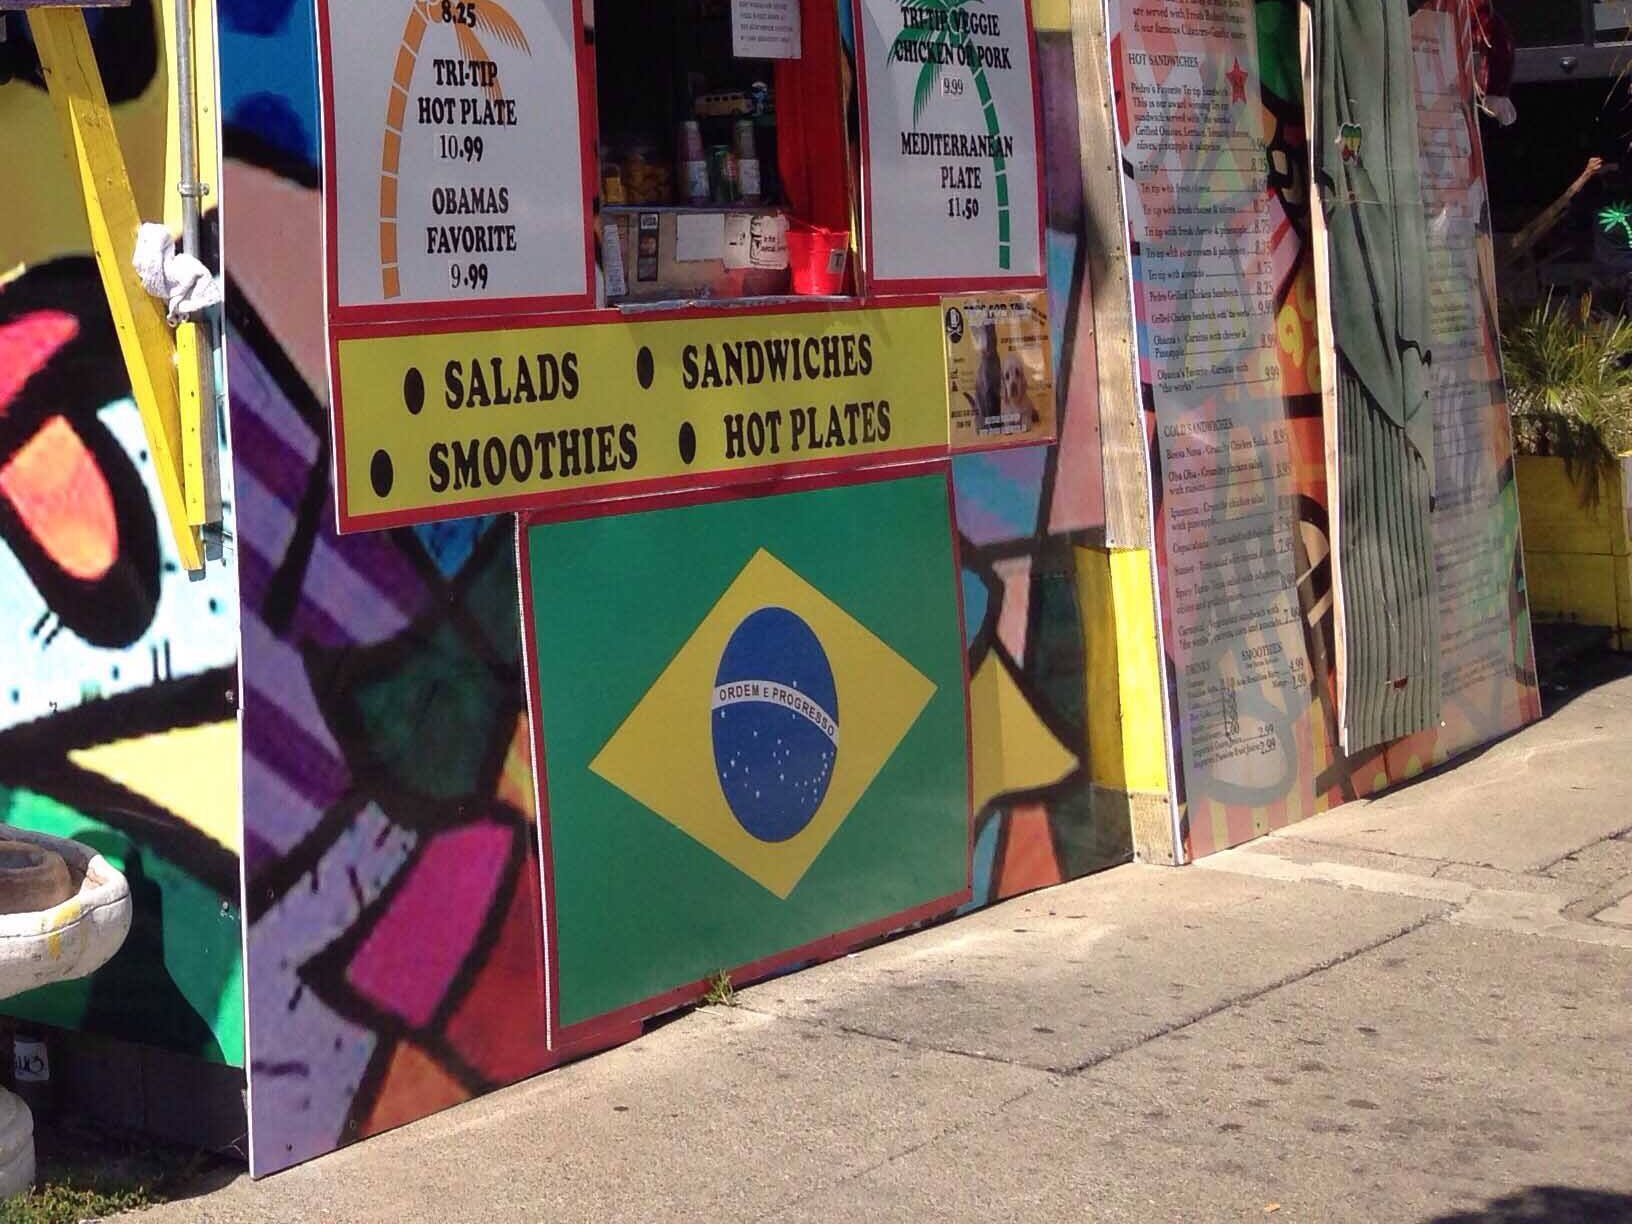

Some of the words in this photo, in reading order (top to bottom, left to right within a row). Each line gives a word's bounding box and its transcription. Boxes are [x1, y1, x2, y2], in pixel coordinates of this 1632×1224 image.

[441, 0, 477, 27] 8.25
[953, 8, 1001, 37] VEGGIE
[895, 39, 954, 65] CHICKEN
[977, 46, 1012, 70] PORK
[1128, 53, 1146, 65] HOT
[1149, 54, 1199, 68] SANDWICHES
[433, 59, 498, 87] TRI-TIP
[943, 78, 964, 95] 9.99
[417, 97, 456, 125] HOT
[460, 98, 518, 126] PLATE
[440, 135, 484, 162] 10.99
[901, 132, 1013, 158] MEDITERRANEAN
[941, 166, 982, 189] PLATE
[432, 187, 509, 215] OBAMAS
[948, 197, 979, 220] 11.50
[427, 225, 517, 254] FAVORITE
[451, 263, 488, 290] 9.99
[444, 351, 580, 410] SALADS
[682, 333, 873, 391] SANDWICHES
[428, 423, 638, 493] SMOOTHIES
[724, 411, 782, 460] HOT
[790, 400, 891, 453] PLATES
[719, 684, 760, 701] ORDEM
[763, 687, 770, 698] E
[772, 687, 835, 737] PROGRESSO
